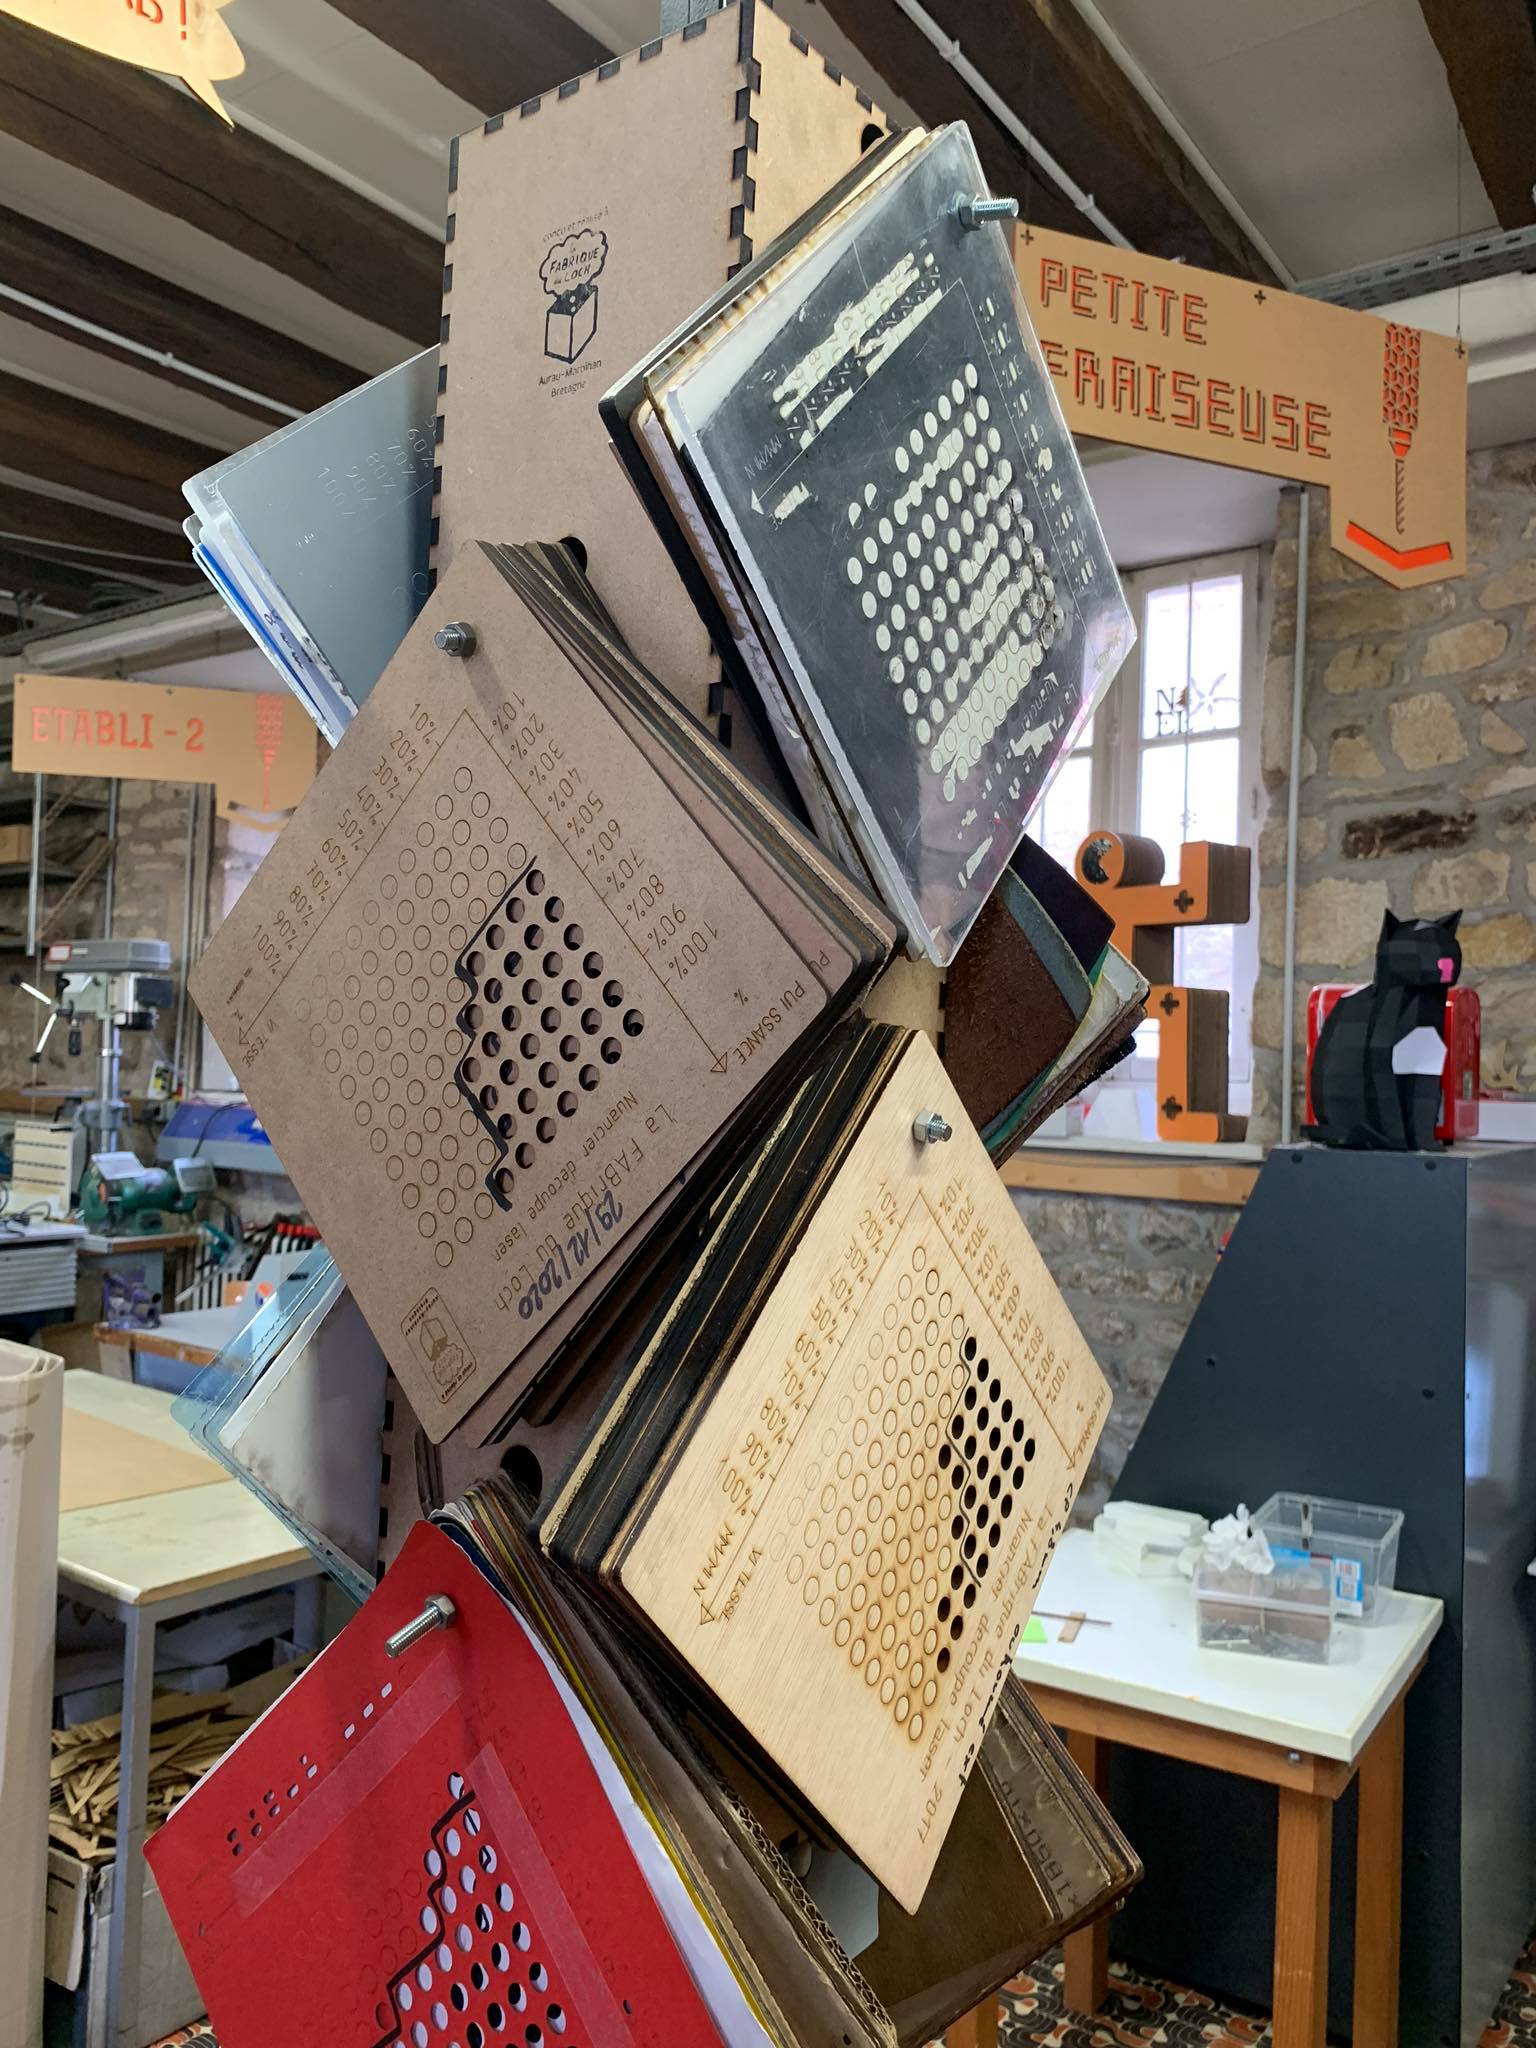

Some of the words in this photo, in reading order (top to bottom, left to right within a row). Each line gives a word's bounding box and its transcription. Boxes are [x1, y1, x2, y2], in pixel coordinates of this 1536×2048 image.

[550, 247, 599, 274] FABRIQUE
[564, 264, 591, 282] LOCH
[1040, 257, 1208, 346] PETITE
[1040, 340, 1332, 459] FRAISEUSE
[409, 703, 438, 745] 10%
[492, 691, 525, 735] 10%
[390, 730, 418, 772] 20%
[510, 713, 544, 760] 20%
[372, 756, 400, 799] 30%
[529, 739, 565, 785] 30%
[355, 784, 383, 826] 40%
[547, 767, 582, 812] 40%
[338, 810, 366, 852] 50%
[566, 790, 604, 838] 50%
[321, 838, 348, 877] 60%
[587, 819, 620, 865] 60%
[306, 859, 331, 902] 70%
[606, 848, 645, 893] 70%
[289, 885, 314, 926] 80%
[627, 874, 664, 921] 80%
[273, 910, 298, 950] 90%
[647, 903, 686, 950] 90%
[252, 925, 281, 975] 100%
[668, 921, 718, 980] 100%
[582, 1090, 639, 1158] Nuancier
[644, 1103, 678, 1134] La
[527, 1160, 577, 1220] decoupe
[877, 1182, 898, 1224] 10%
[494, 1222, 528, 1262] laser
[859, 1210, 884, 1253] 20%
[844, 1233, 868, 1283] 30%
[830, 1268, 854, 1313] 40%
[811, 1296, 838, 1344] 50%
[795, 1333, 821, 1376] 60%
[779, 1360, 805, 1410] 70%
[760, 1397, 788, 1444] 80%
[741, 1432, 770, 1479] 90%
[716, 1457, 752, 1516] 100%
[992, 1508, 1033, 1601] Nuancier
[919, 1718, 950, 1784] laser
[917, 1782, 943, 1844] 2017
